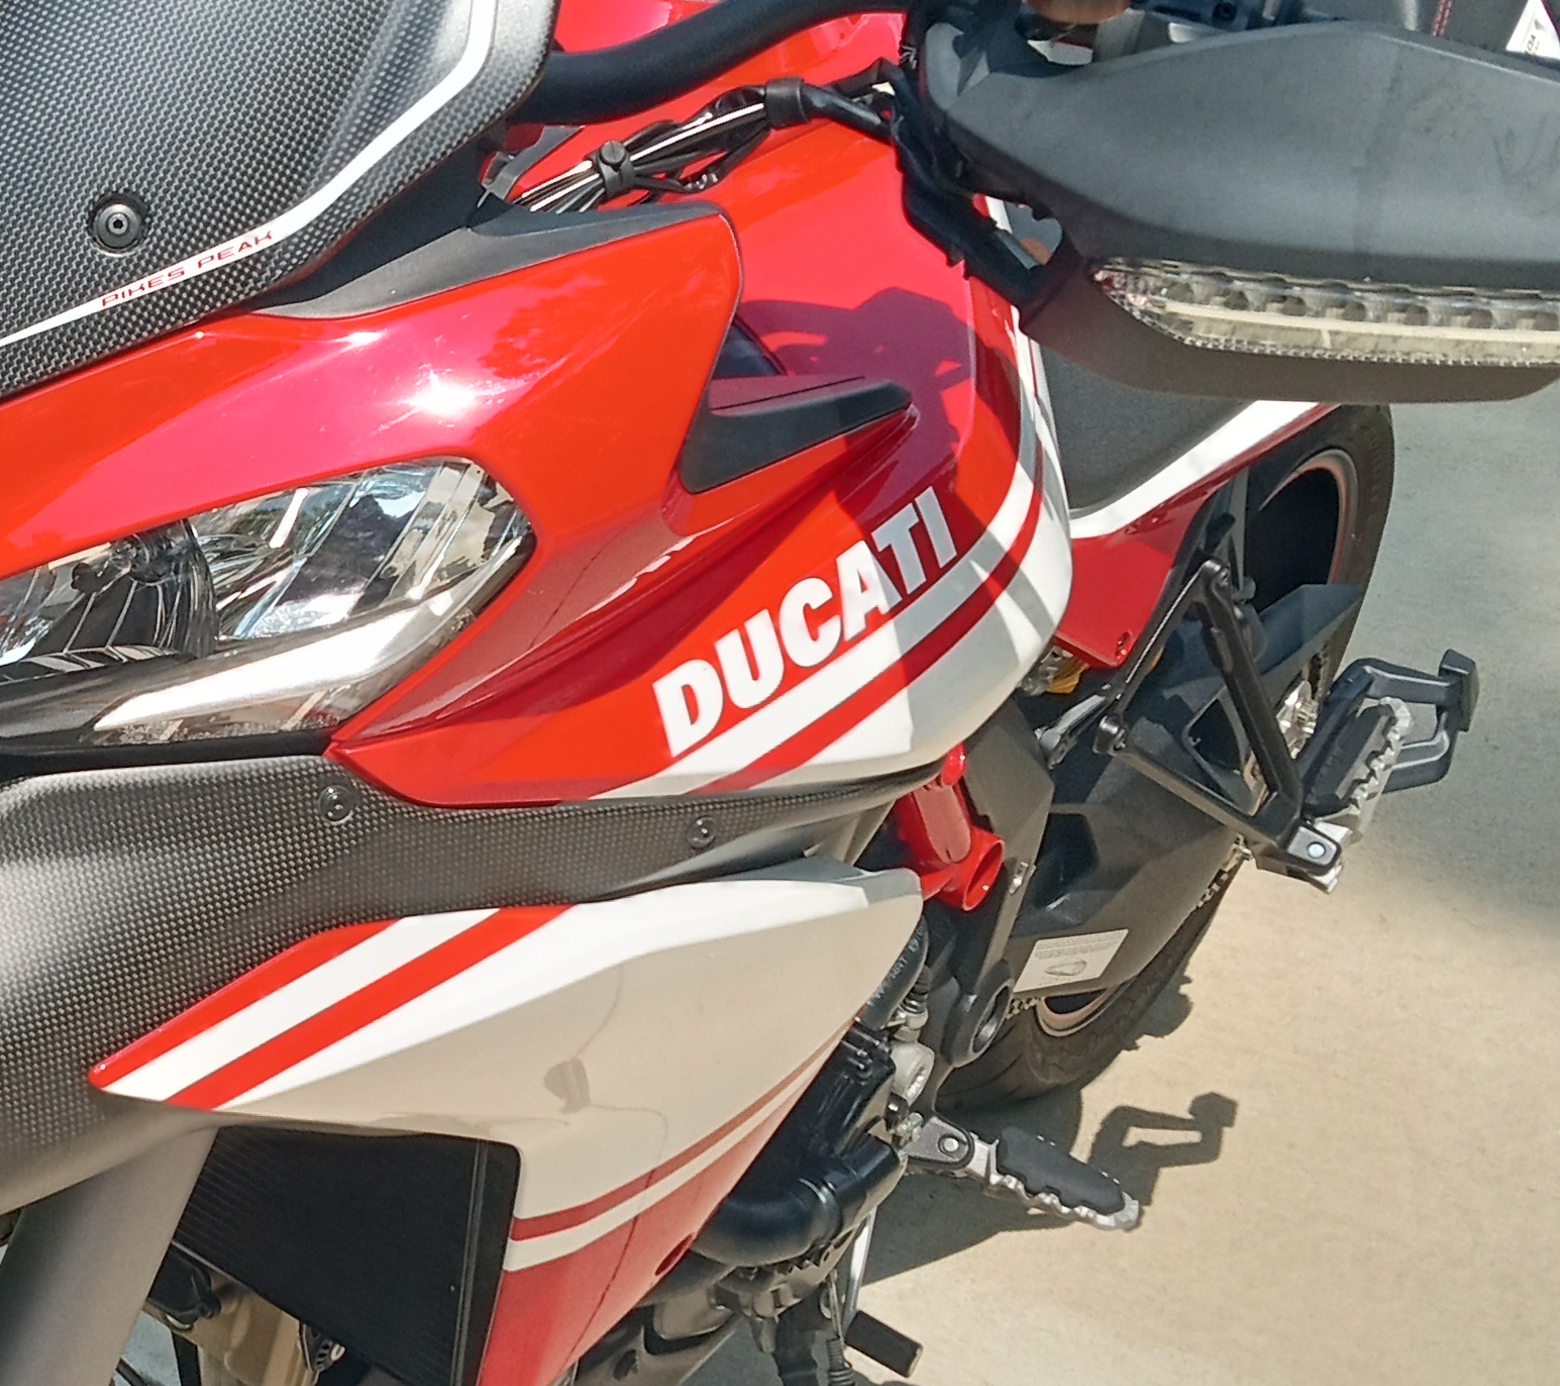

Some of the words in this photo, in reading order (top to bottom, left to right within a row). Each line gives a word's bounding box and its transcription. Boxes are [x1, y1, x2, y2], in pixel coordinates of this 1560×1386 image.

[102, 266, 186, 306] PIKES
[198, 231, 272, 268] PEAK
[652, 486, 958, 758] DUCATI
